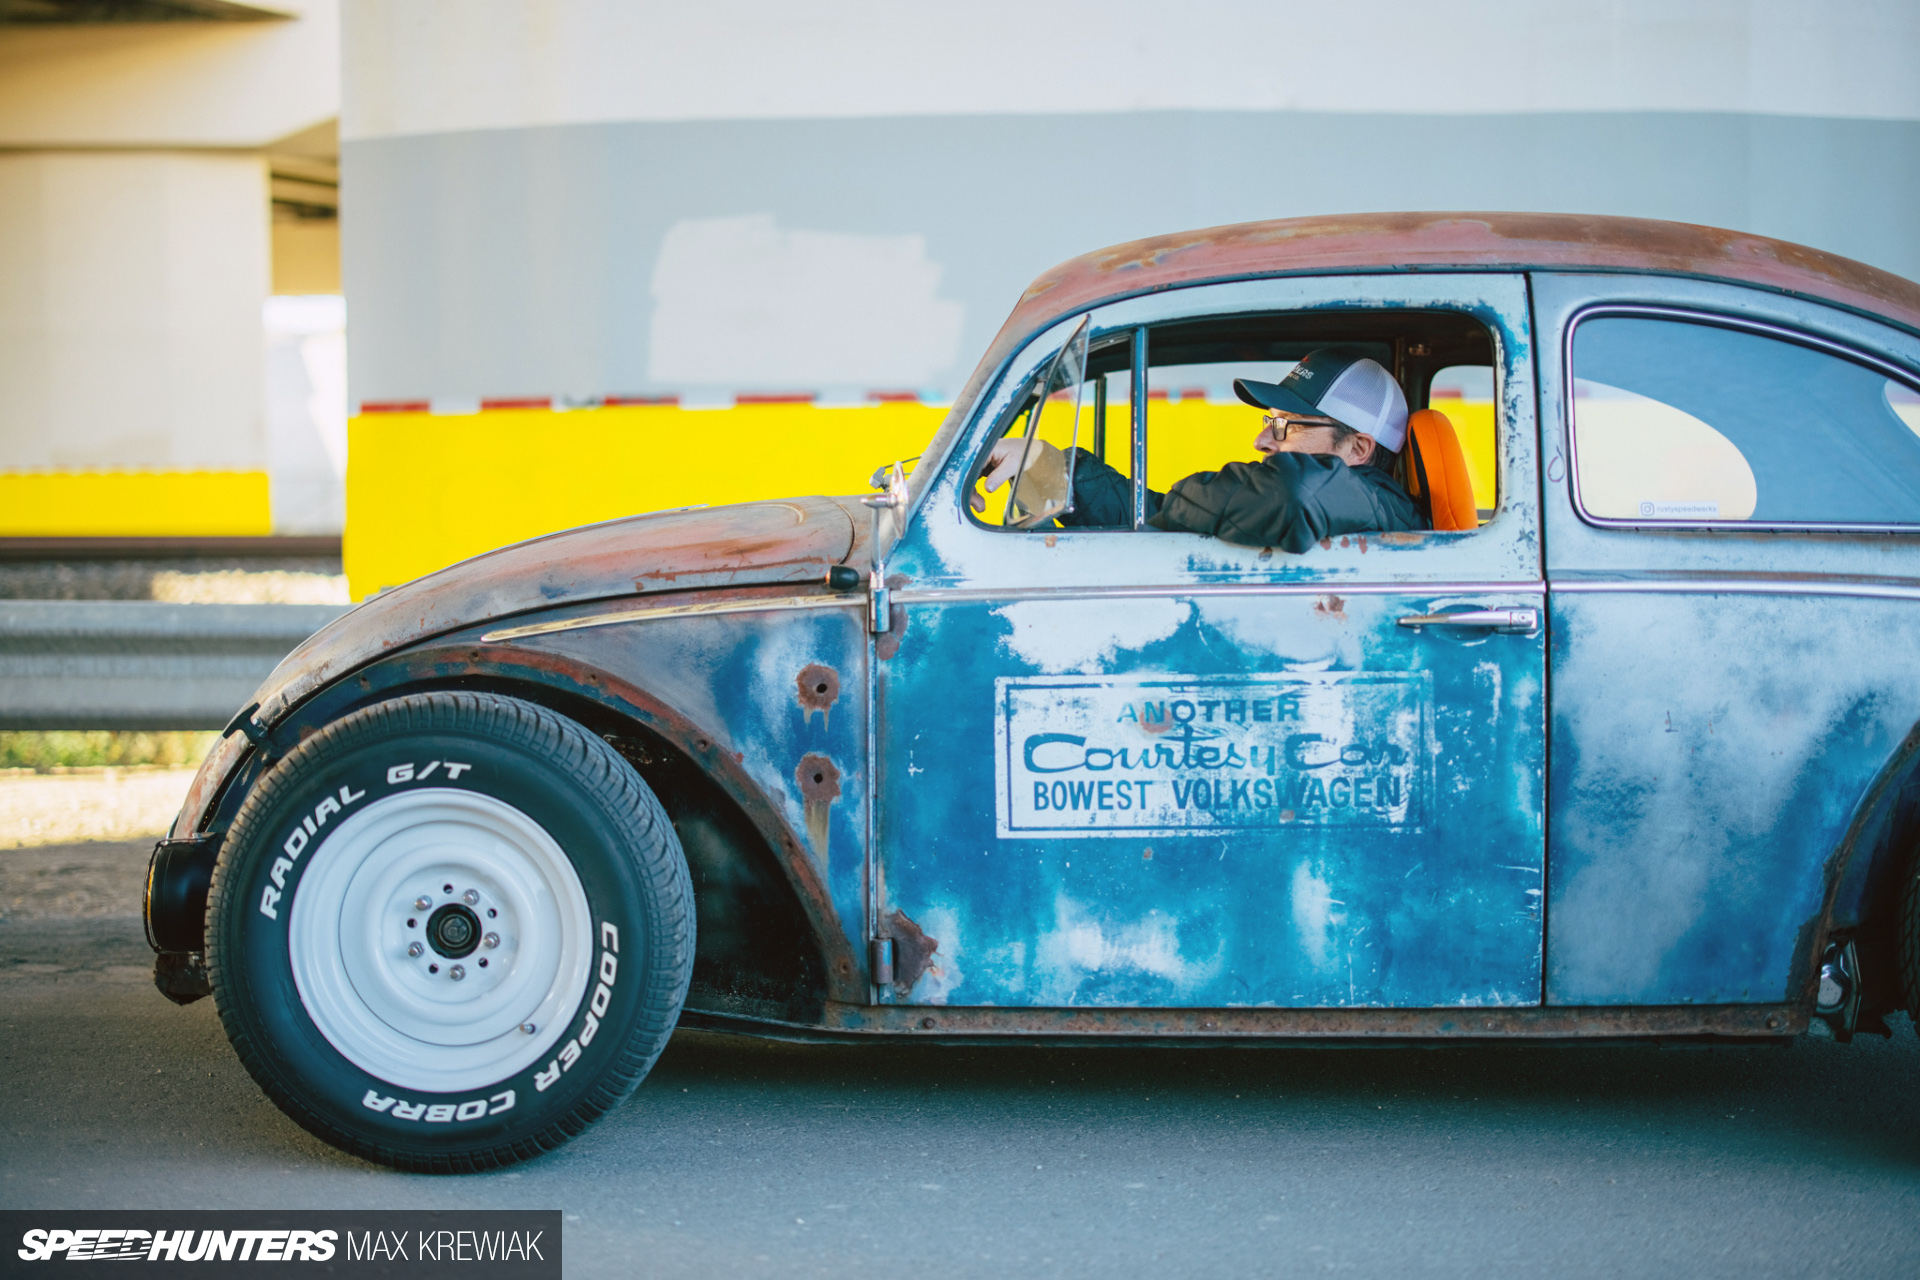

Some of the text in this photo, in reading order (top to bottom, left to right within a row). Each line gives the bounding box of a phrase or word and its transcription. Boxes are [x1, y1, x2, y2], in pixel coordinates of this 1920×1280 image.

[1117, 700, 1300, 723] ANOTHER
[1023, 722, 1407, 776] Courtesy Car
[1034, 777, 1401, 811] BOWEST VOLKSWAGEN
[260, 761, 471, 920] RADIAL G/T
[362, 921, 618, 1122] COOPER COBRA
